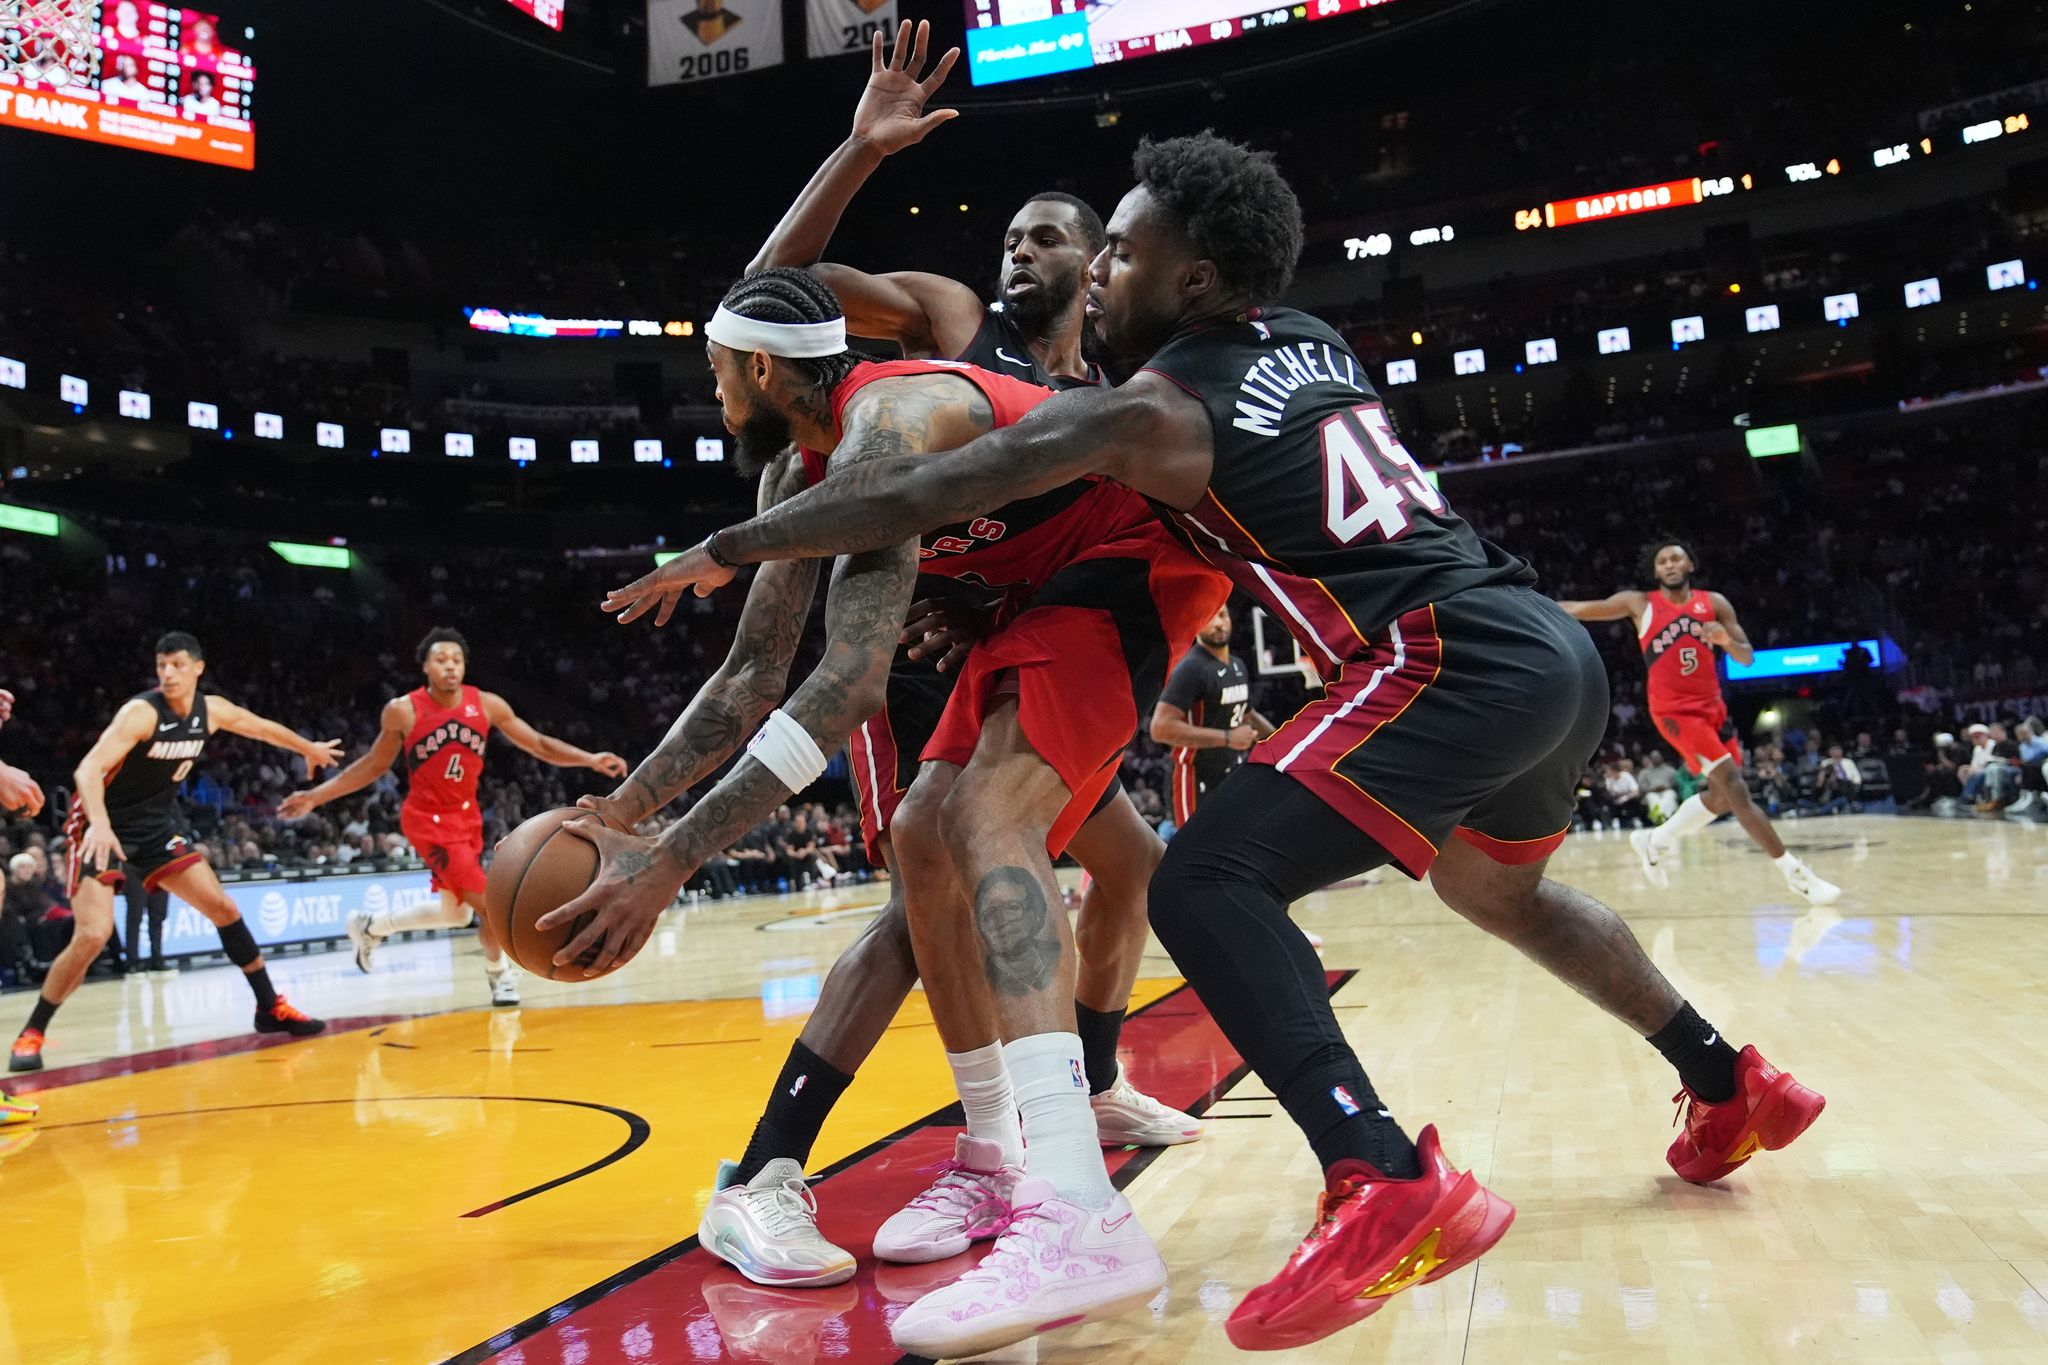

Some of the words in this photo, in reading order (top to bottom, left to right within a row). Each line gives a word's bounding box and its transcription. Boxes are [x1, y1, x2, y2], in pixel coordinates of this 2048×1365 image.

[1154, 28, 1192, 52] MIA
[680, 48, 749, 80] 2006
[15, 92, 89, 130] BANK
[1515, 208, 1542, 231] 54
[1576, 187, 1671, 219] RAPTORS
[1741, 173, 1753, 190] 1
[1232, 342, 1363, 437] MITCHELL
[1320, 403, 1444, 547] 45
[1679, 647, 1699, 676] 5
[444, 753, 464, 783] 4
[174, 906, 217, 938] AT&
[291, 894, 342, 927] AT&T
